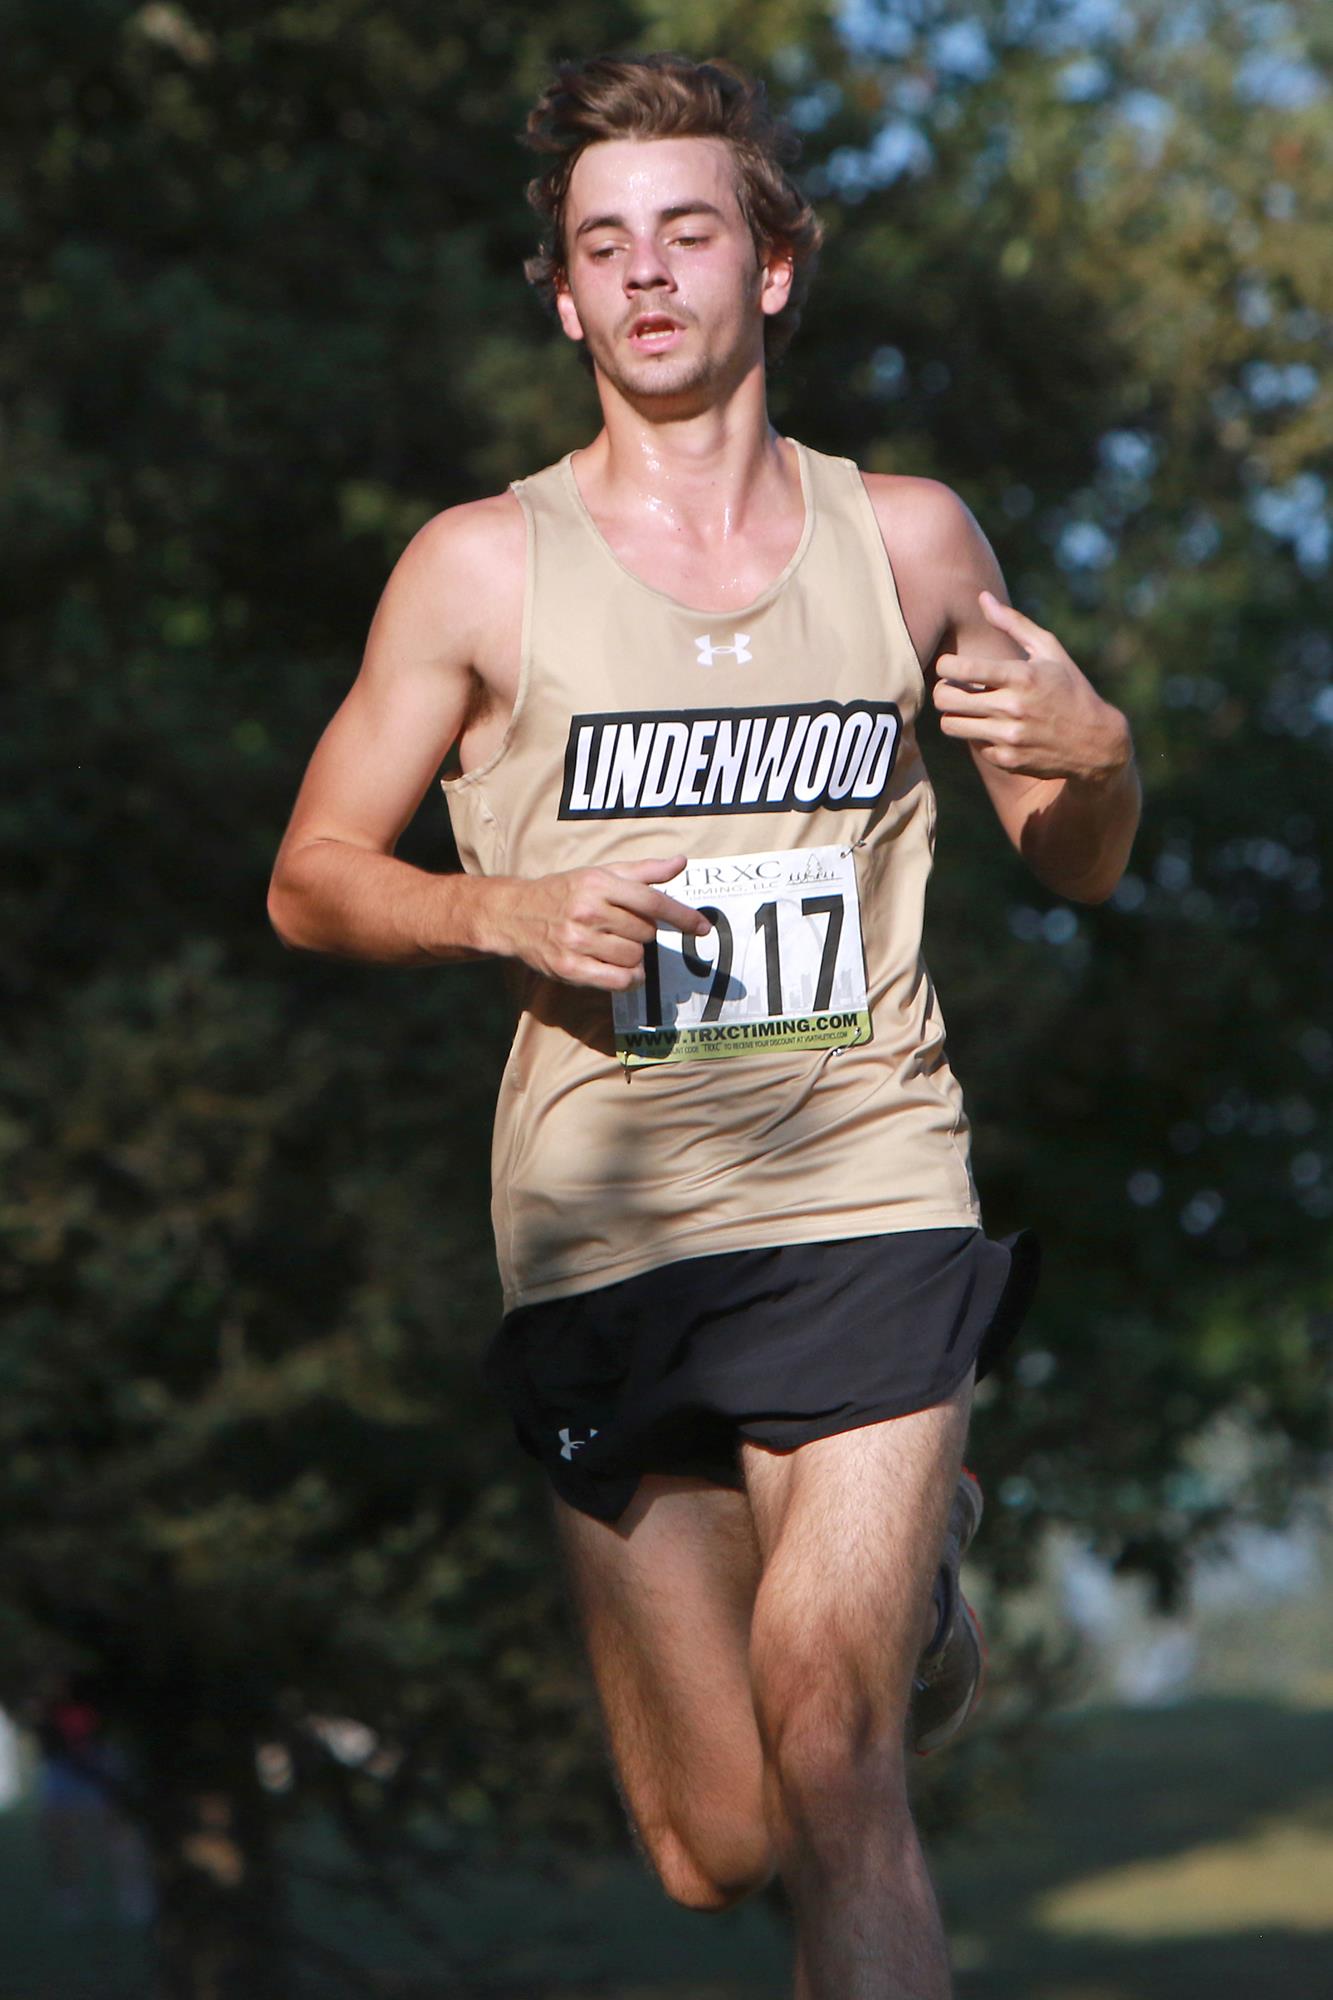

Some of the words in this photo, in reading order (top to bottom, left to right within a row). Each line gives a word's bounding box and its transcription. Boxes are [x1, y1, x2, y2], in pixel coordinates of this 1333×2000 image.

[568, 711, 898, 811] LINDENWOOD
[684, 860, 782, 887] TRXC
[642, 893, 845, 1026] 1917
[625, 1012, 858, 1047] WWW.TRXCTIMING.COM
[769, 1037, 796, 1046] DISCOUNT
